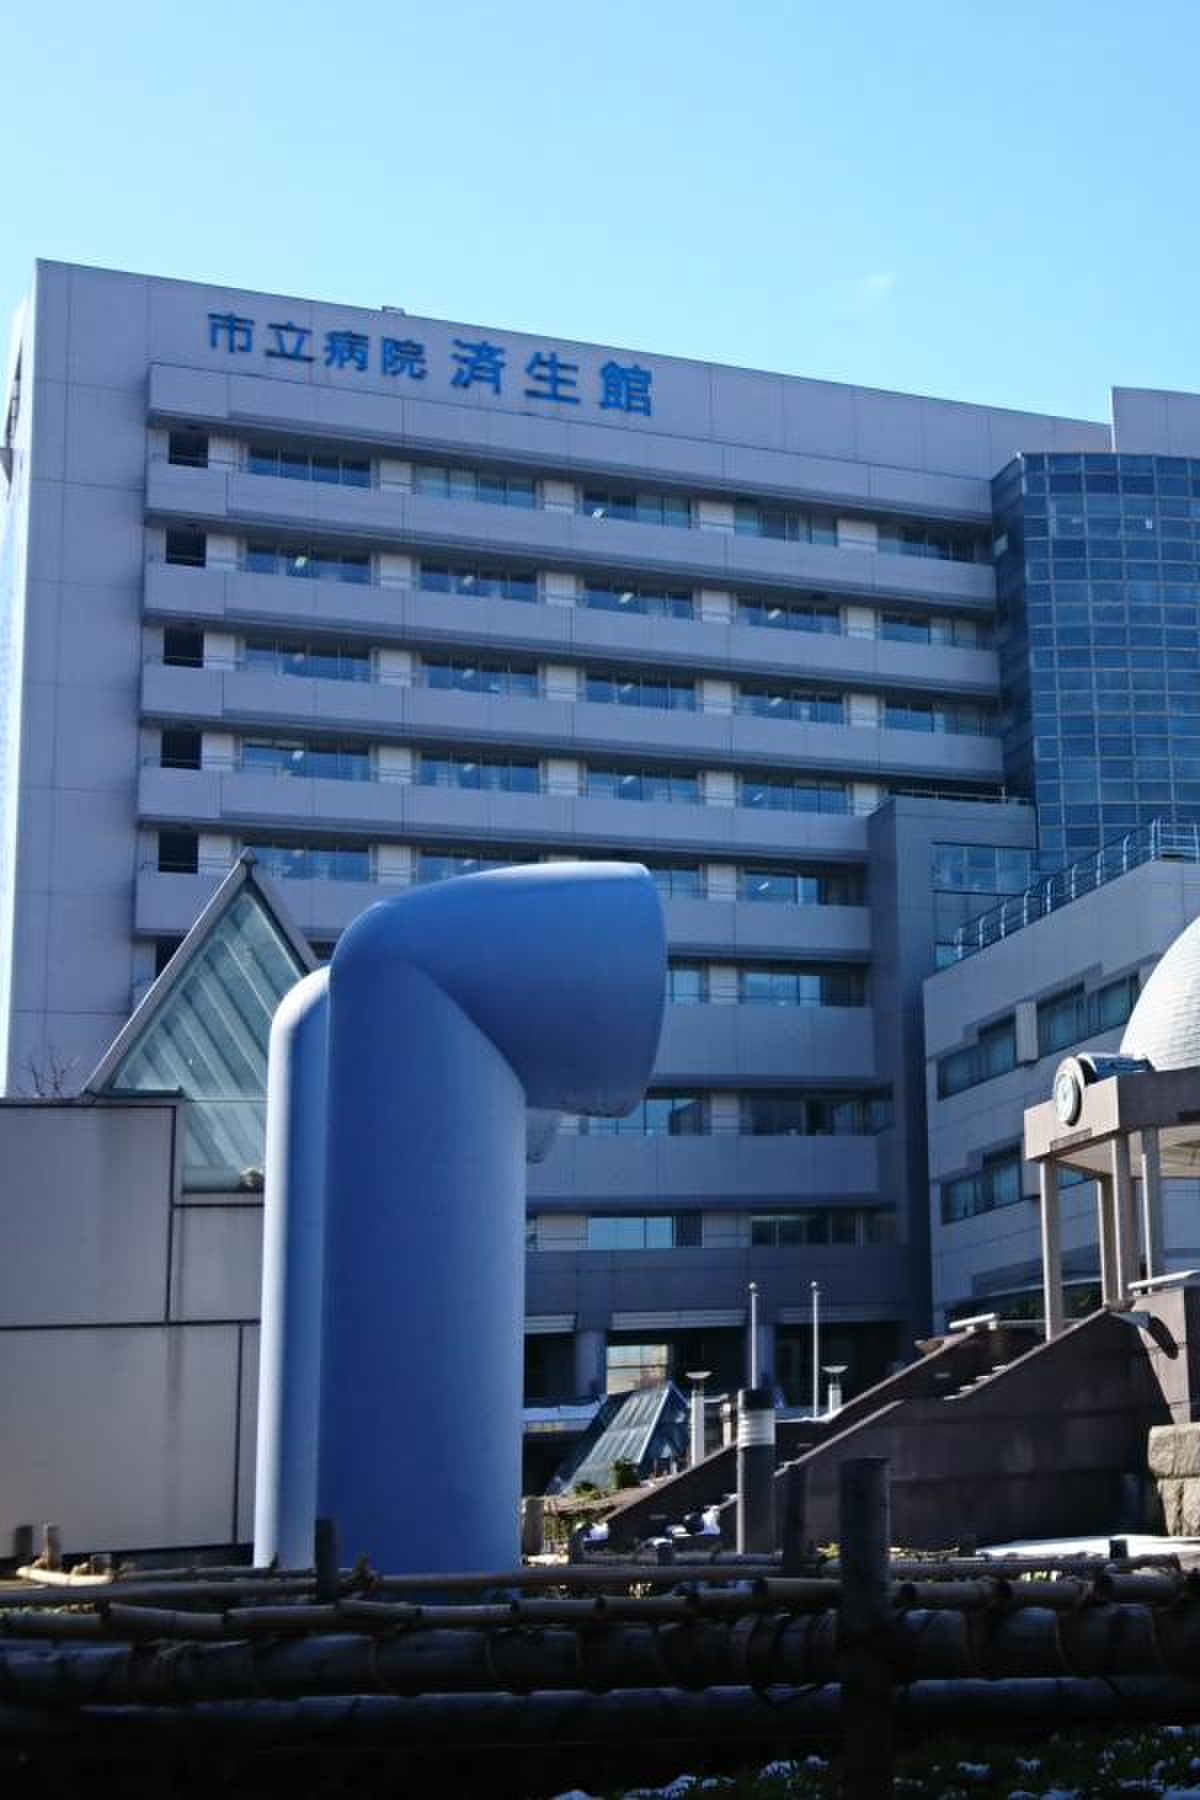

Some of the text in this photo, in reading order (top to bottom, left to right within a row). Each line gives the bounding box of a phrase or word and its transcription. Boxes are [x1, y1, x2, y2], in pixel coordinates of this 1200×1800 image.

[207, 312, 653, 417] 市立病院 済生館
